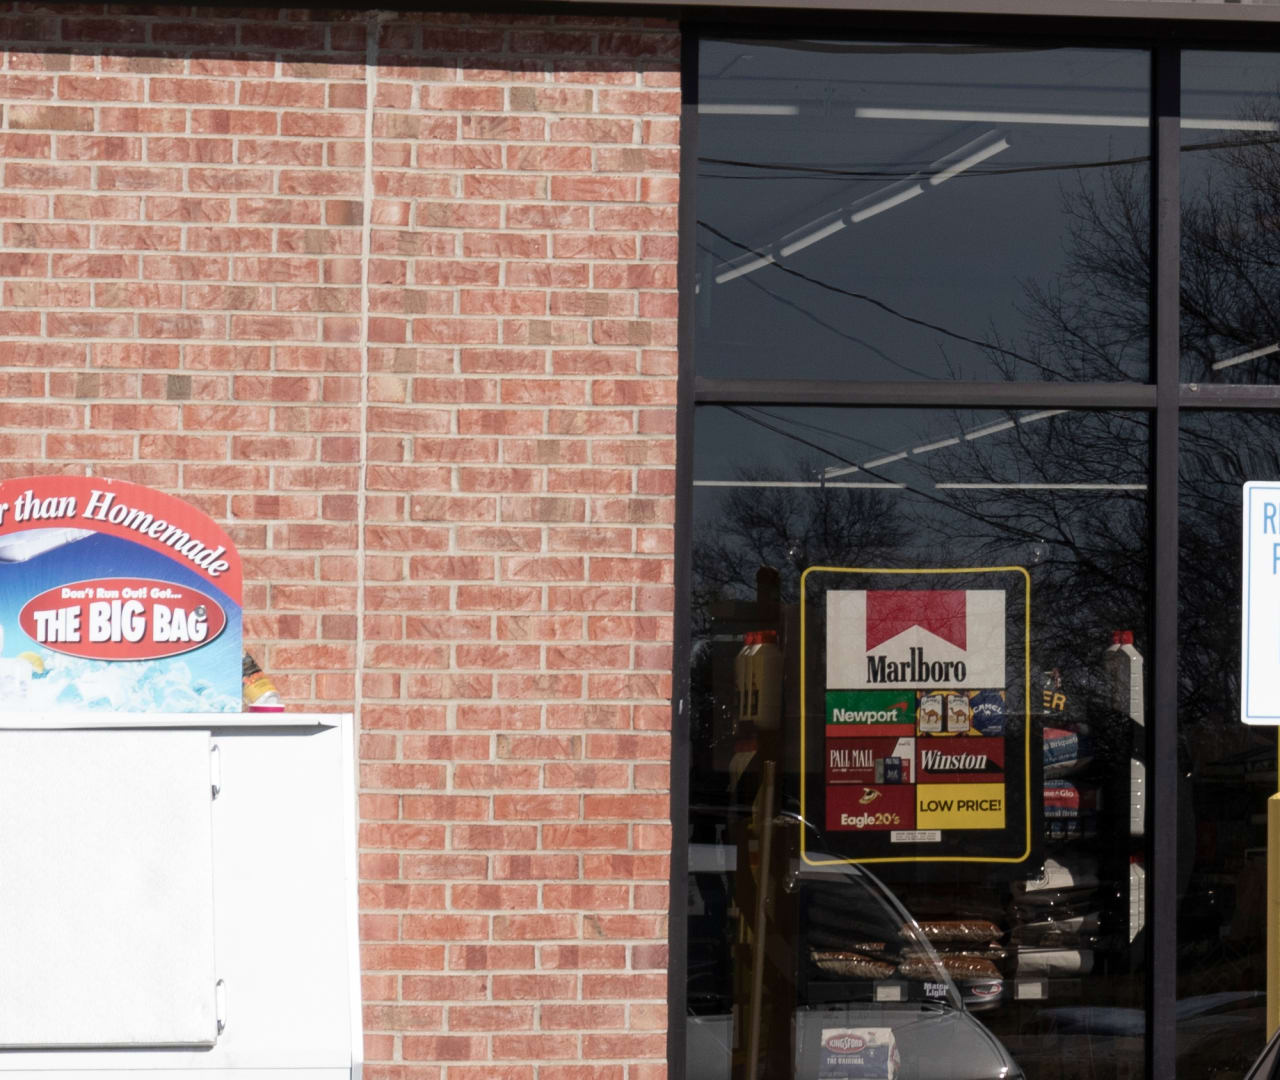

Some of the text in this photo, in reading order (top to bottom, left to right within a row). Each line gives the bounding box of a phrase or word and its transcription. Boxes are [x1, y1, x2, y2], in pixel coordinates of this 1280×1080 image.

[14, 490, 229, 576] than Homemade
[96, 588, 119, 599] Run
[33, 600, 208, 642] THE BIG BAG
[866, 647, 968, 684] Marlboro
[832, 708, 898, 724] Newport
[973, 703, 1003, 714] CAMEL
[830, 749, 875, 768] PALL MALL
[921, 750, 988, 770] Winston
[919, 799, 1002, 812] LOW PRICE!
[840, 812, 900, 828] Eagle20's
[829, 1037, 863, 1049] KINGSFORD
